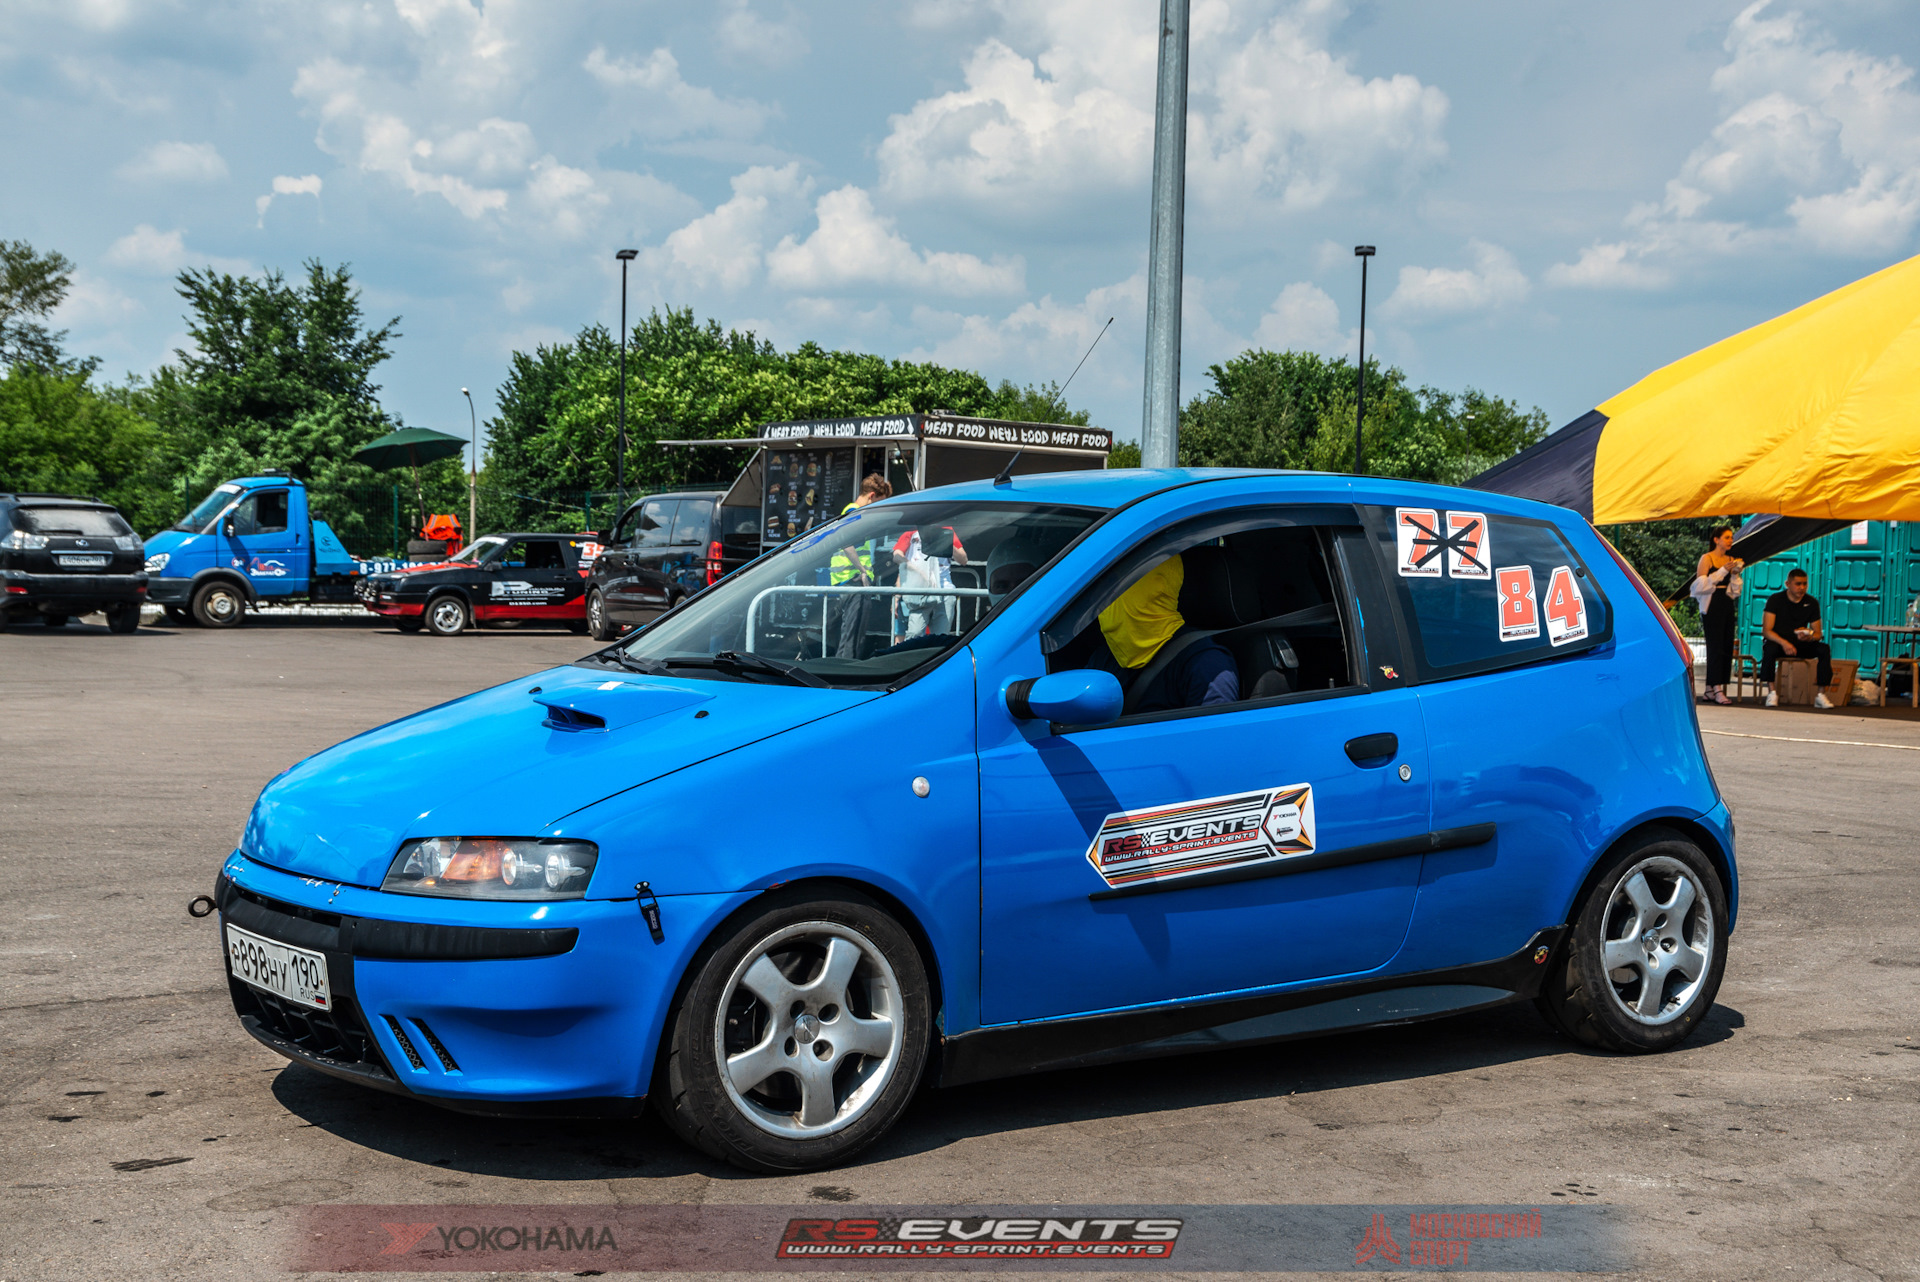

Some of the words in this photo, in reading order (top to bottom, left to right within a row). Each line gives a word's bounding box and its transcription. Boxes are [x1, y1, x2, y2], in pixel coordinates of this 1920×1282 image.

[860, 421, 882, 436] MEAT
[883, 420, 905, 435] FOOD
[924, 420, 954, 435] MEAT
[956, 423, 986, 438] FOOD
[1051, 431, 1079, 446] MEAT
[1081, 432, 1109, 448] FOOD
[1104, 834, 1142, 853] RS
[1149, 814, 1261, 846] EVENTS
[291, 954, 320, 990] 190
[300, 988, 315, 1001] RUS
